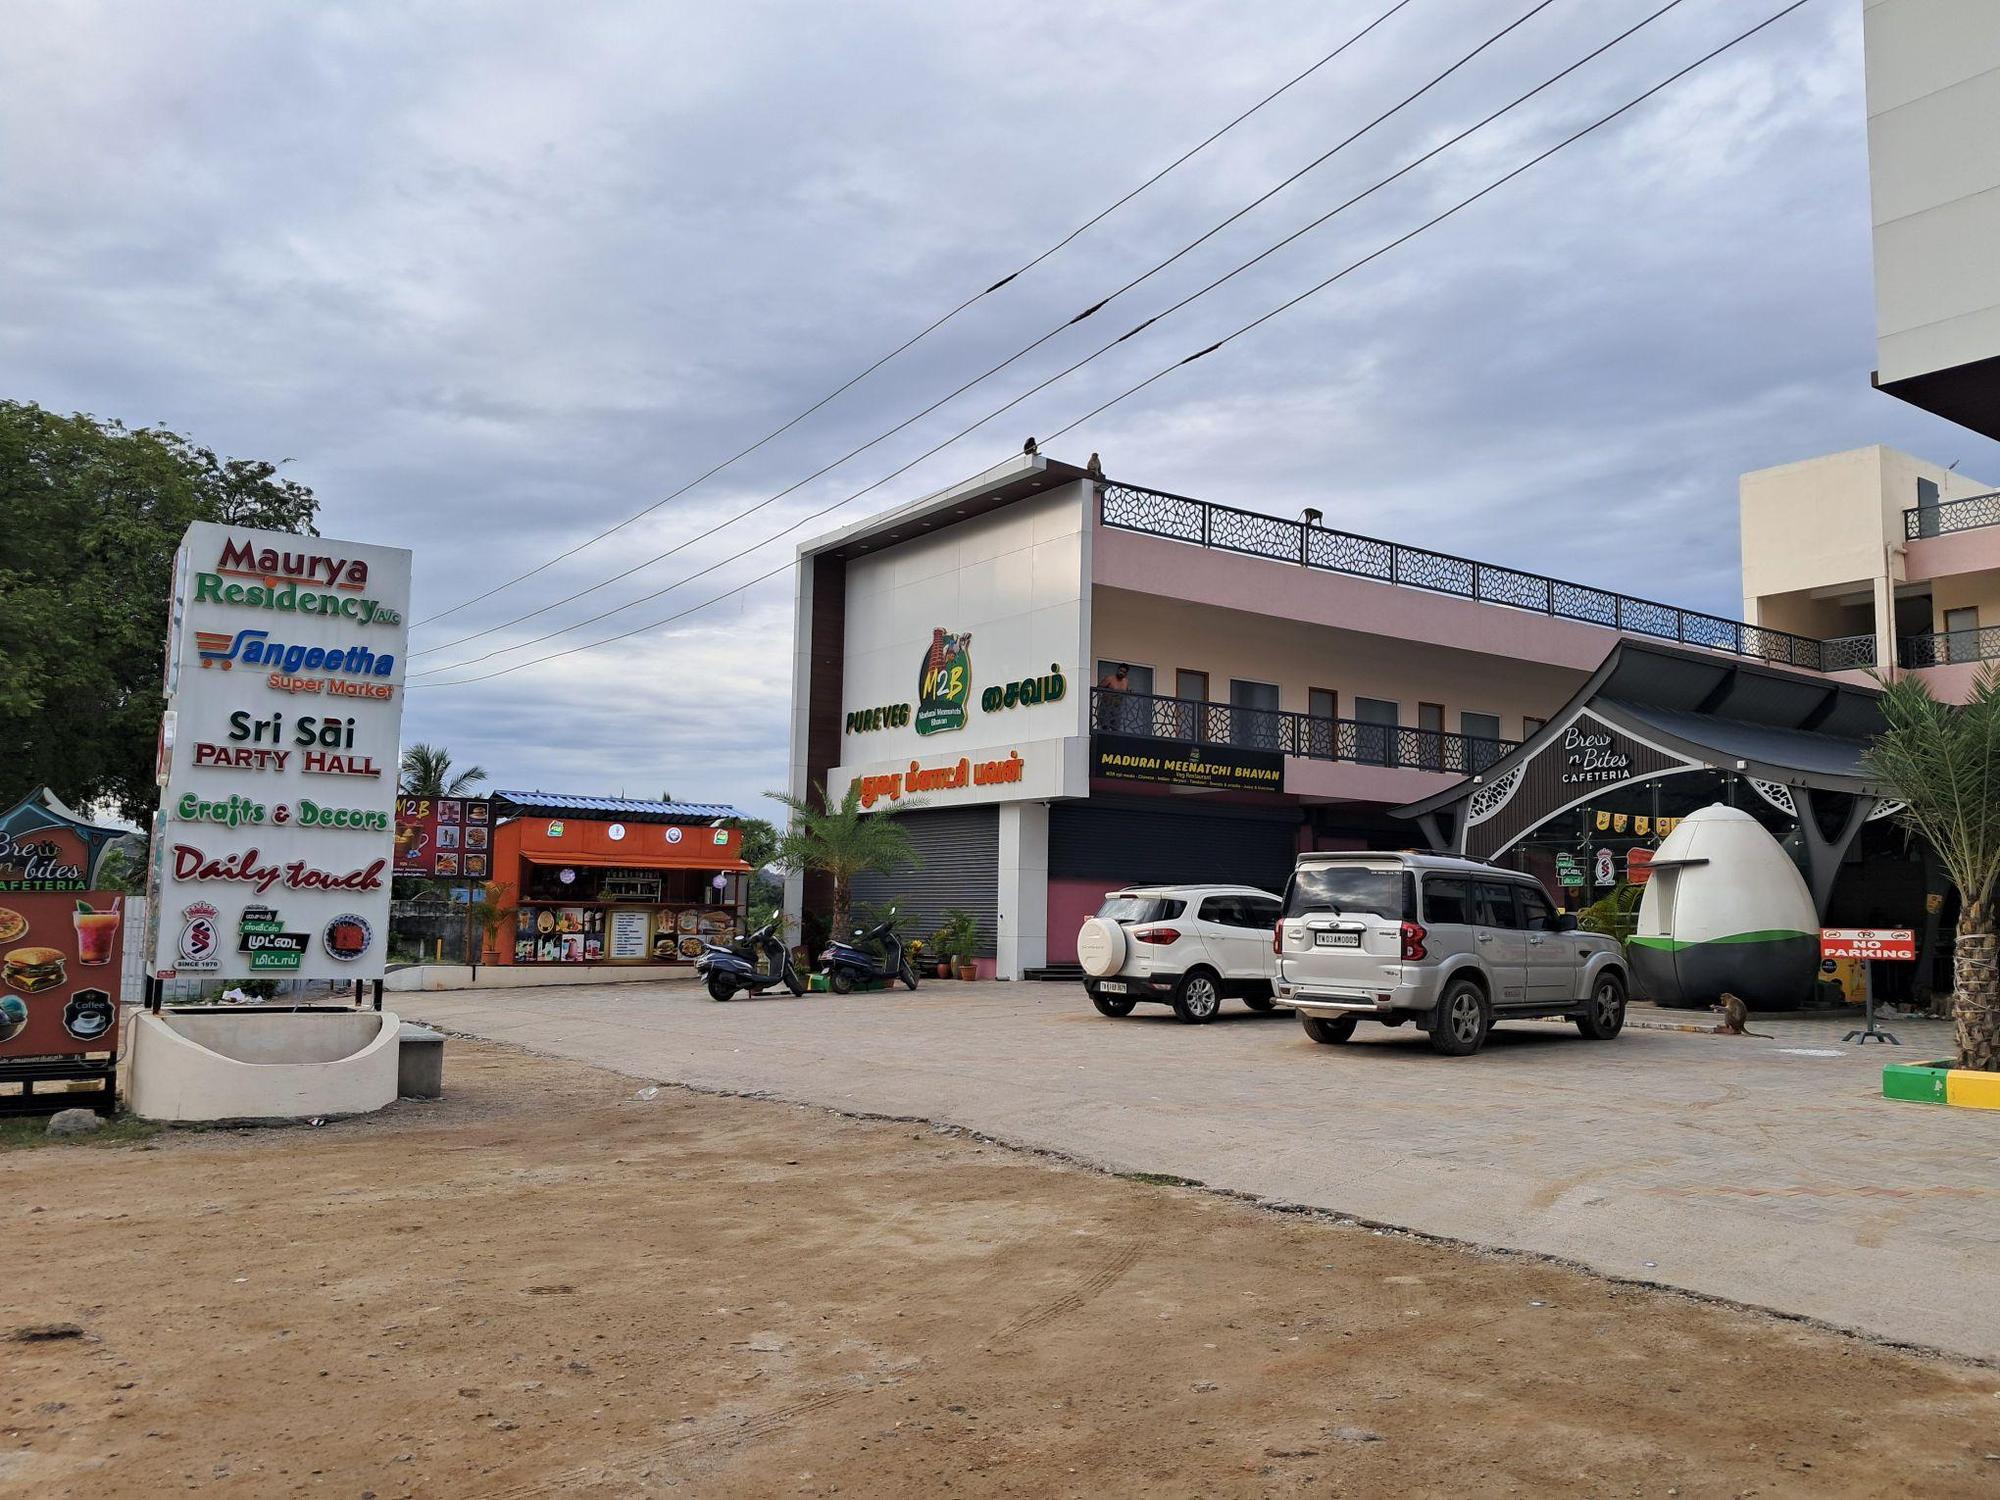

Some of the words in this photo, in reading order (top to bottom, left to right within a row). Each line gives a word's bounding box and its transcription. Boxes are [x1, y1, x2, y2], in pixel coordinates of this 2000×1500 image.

[217, 537, 368, 586] Maurya
[195, 573, 379, 624] Residency
[199, 630, 394, 677] Sangeetha
[267, 673, 324, 693] Super
[328, 681, 394, 699] Market
[922, 667, 963, 700] M2B
[982, 663, 1066, 712] சைவம்
[229, 711, 282, 743] Sri
[296, 716, 355, 748] Sai
[1565, 727, 1611, 749] Brew
[195, 744, 291, 769] PARTY
[303, 750, 380, 776] HALL
[1102, 753, 1160, 769] MADURAI
[1164, 760, 1231, 776] MEENATCHI
[1235, 767, 1280, 780] BHAVAN
[1583, 748, 1629, 770] Bites
[1562, 769, 1630, 783] CAFETERIA
[179, 793, 265, 827] Crafts
[273, 805, 290, 823] &
[298, 800, 388, 831] Decors
[396, 799, 430, 819] M2B
[174, 844, 280, 893] Daily
[285, 859, 387, 891] touch
[248, 934, 302, 950] முட்டை
[1824, 949, 1912, 958] PARKING
[1853, 941, 1881, 949] NO
[255, 953, 298, 966] மிட்டாய்
[75, 1001, 105, 1009] Coffee
